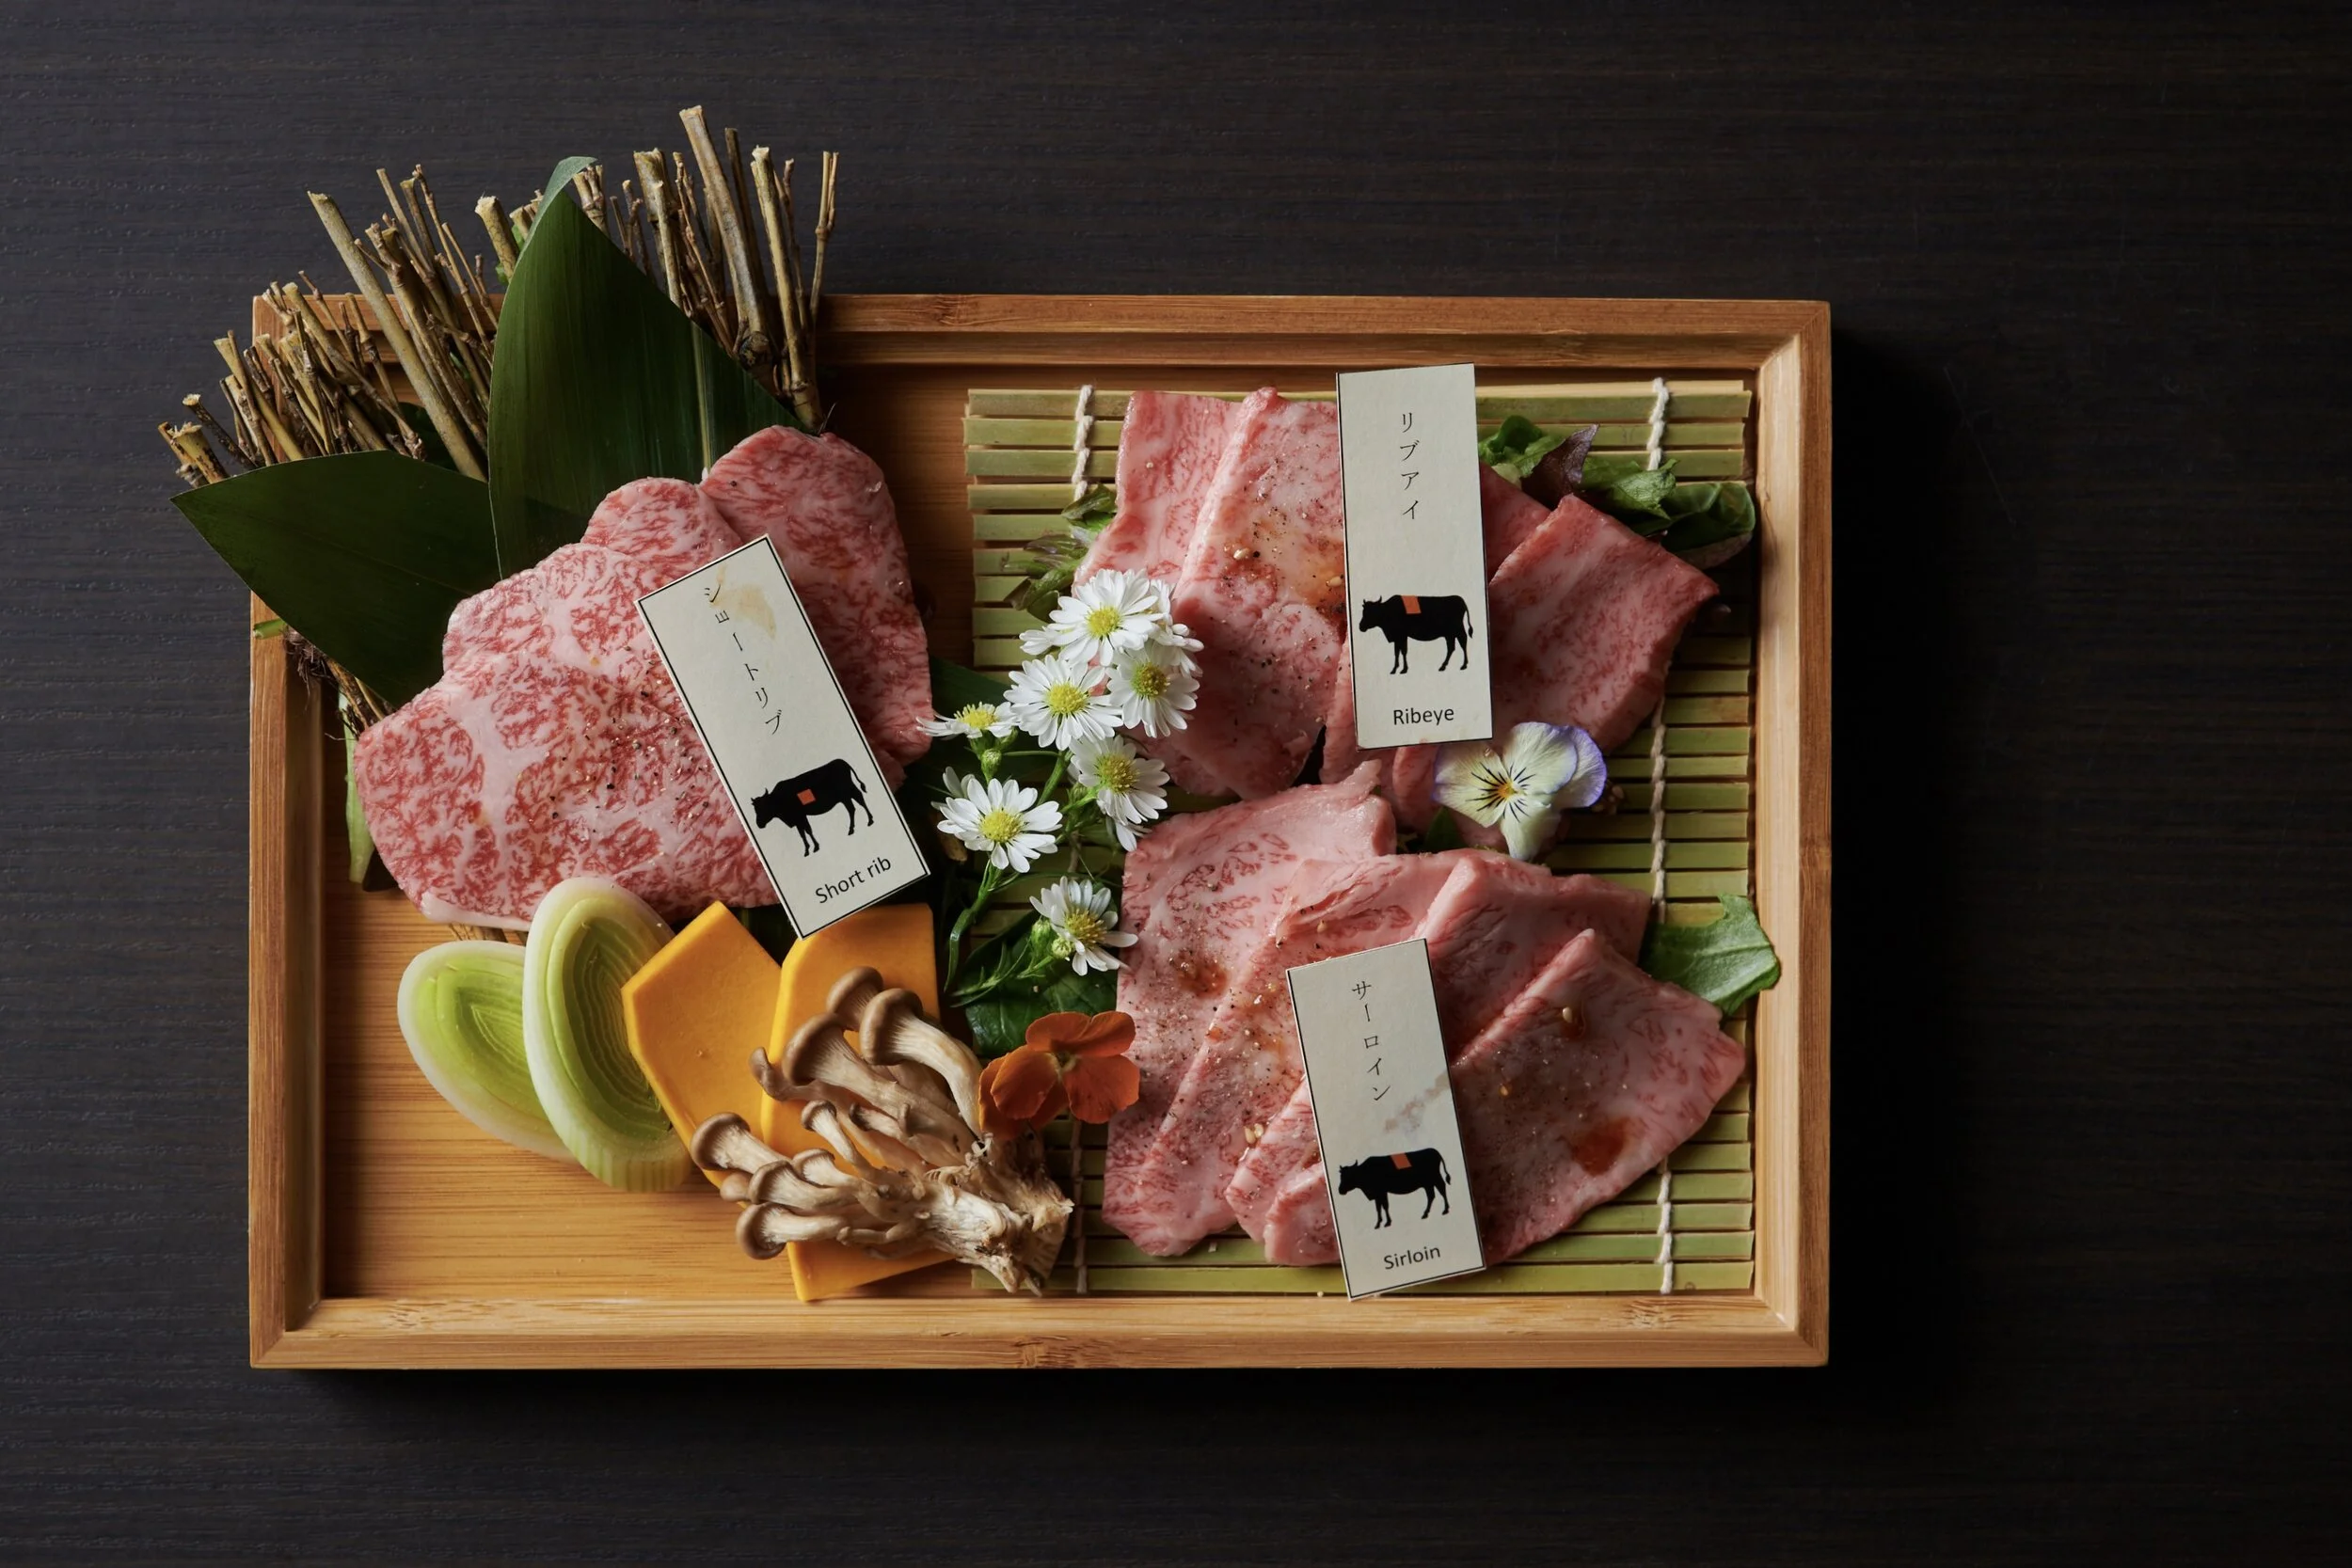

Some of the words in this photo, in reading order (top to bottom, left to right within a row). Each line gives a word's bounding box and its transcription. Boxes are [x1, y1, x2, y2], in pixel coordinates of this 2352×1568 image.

[1399, 412, 1420, 520] リブアイ
[704, 583, 782, 735] ショートリブ
[1392, 707, 1454, 725] Ribeye
[815, 870, 866, 904] Short
[866, 857, 891, 879] rib
[1351, 980, 1391, 1101] サーロイン
[1383, 1245, 1441, 1270] Sirloin
